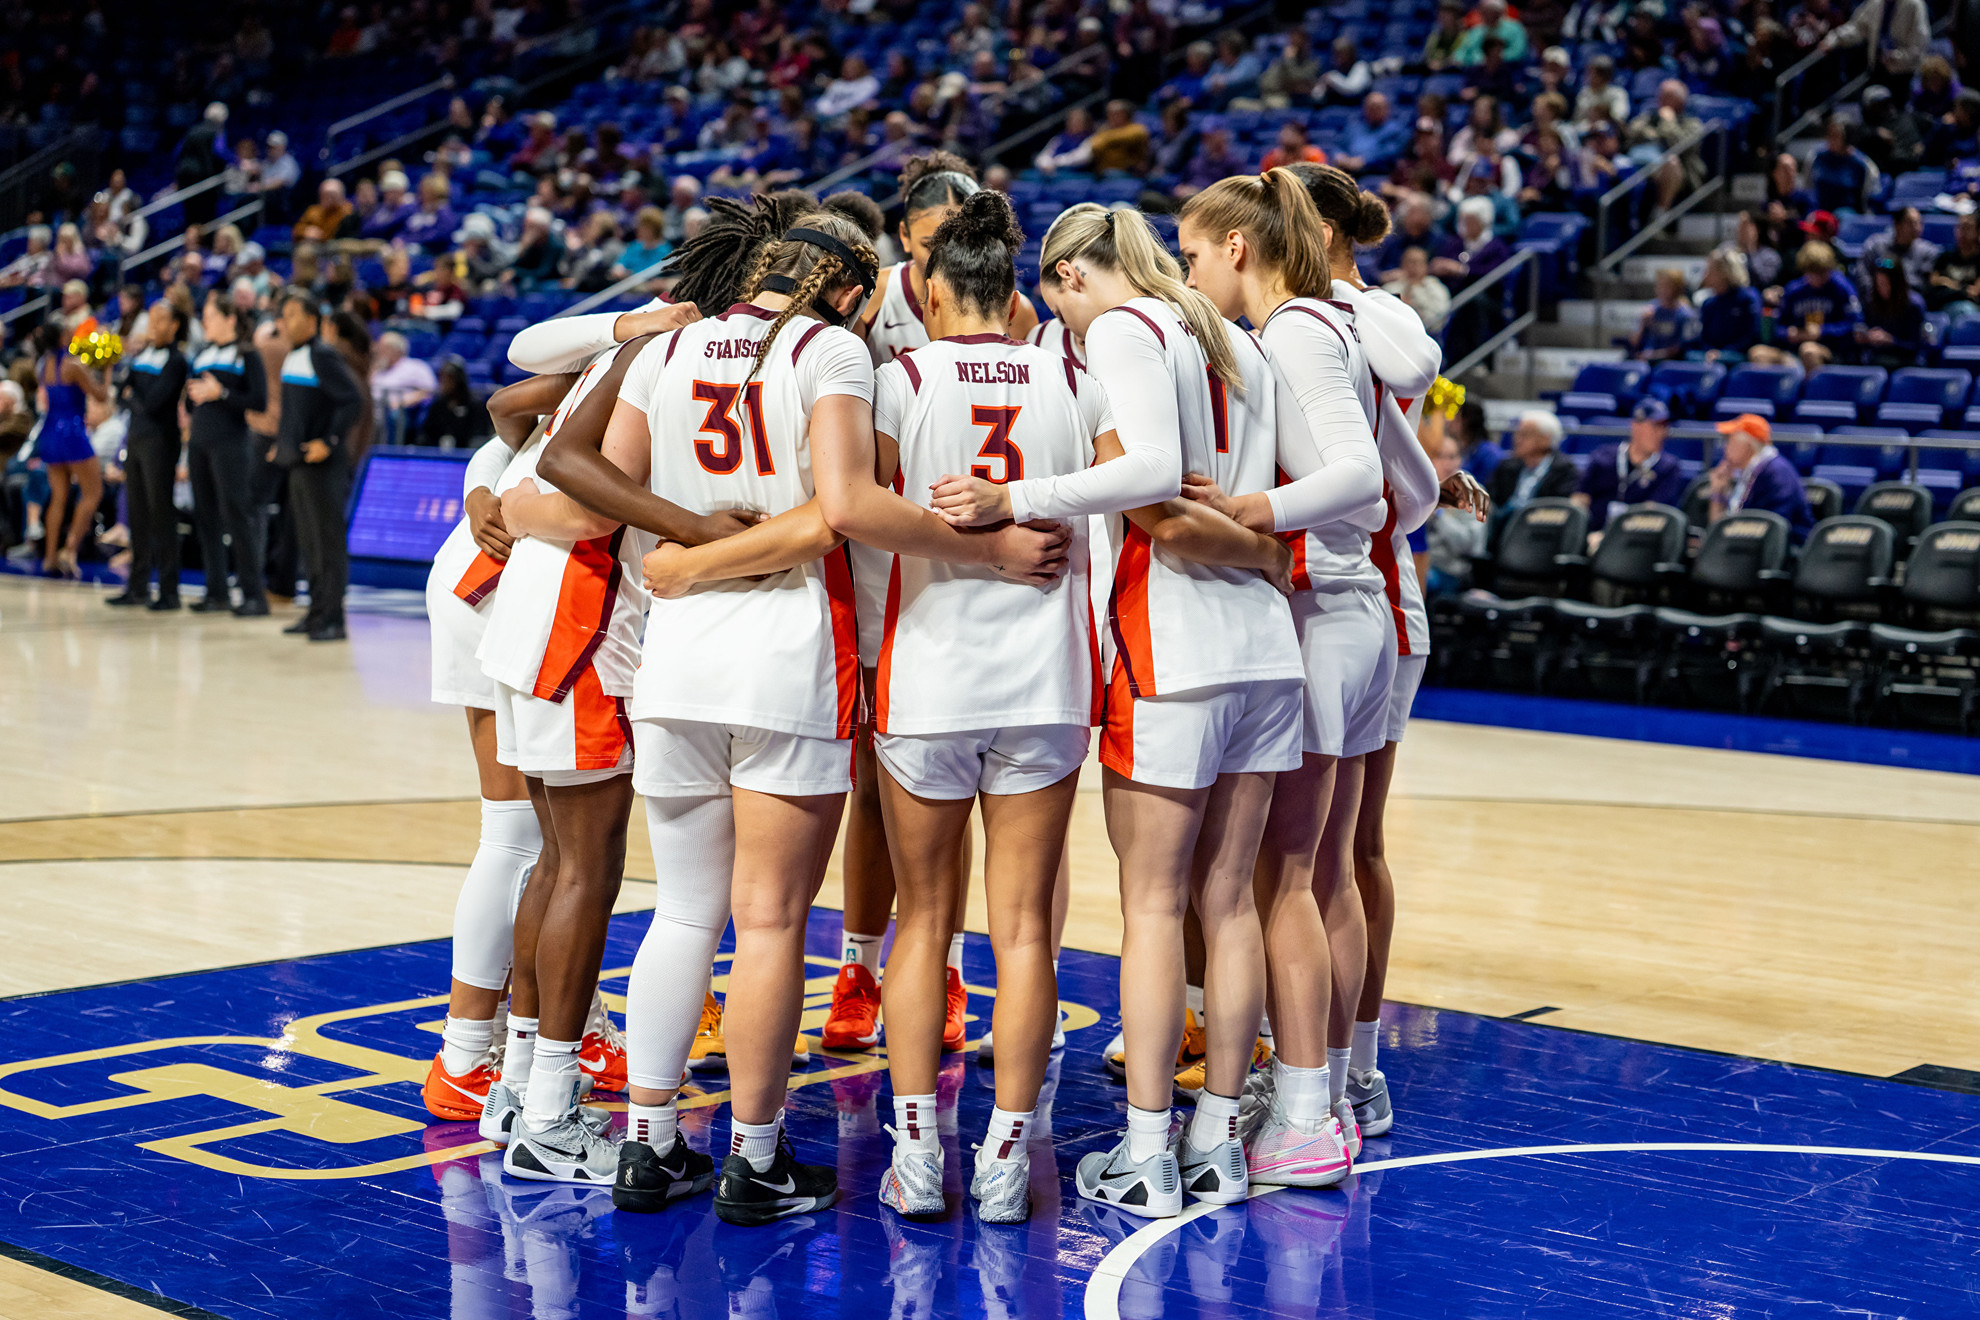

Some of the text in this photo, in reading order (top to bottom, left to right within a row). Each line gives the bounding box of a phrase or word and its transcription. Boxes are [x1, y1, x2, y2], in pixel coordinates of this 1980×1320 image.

[703, 338, 762, 360] SWANSO
[955, 361, 1030, 385] NELSON
[692, 379, 776, 476] 31
[971, 404, 1024, 484] 3
[986, 1170, 1006, 1185] TWELVE
